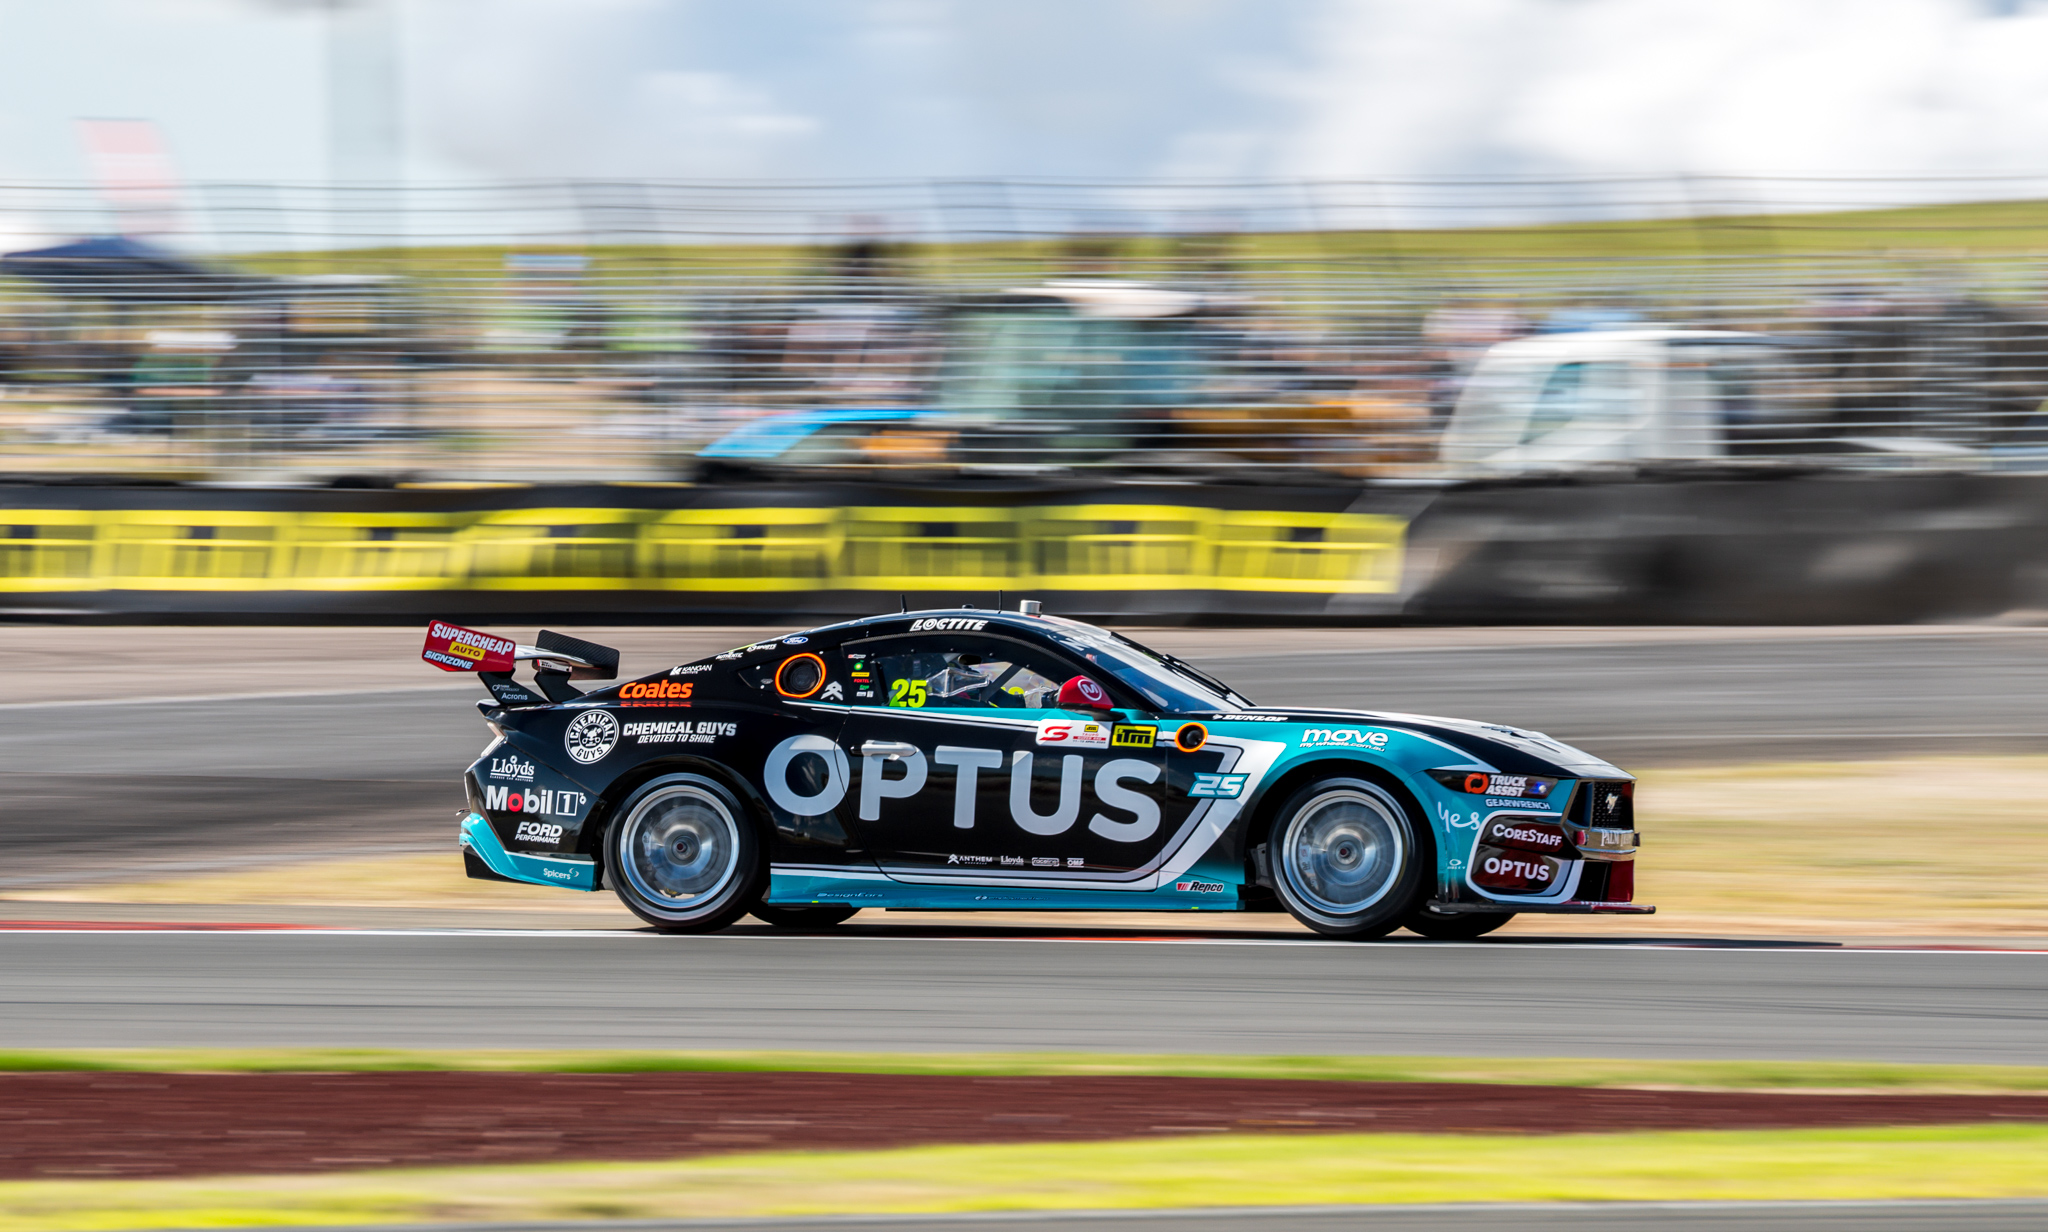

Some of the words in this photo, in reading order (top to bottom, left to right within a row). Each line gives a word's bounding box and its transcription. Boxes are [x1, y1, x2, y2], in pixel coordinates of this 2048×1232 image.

[909, 618, 988, 632] LOCTITE
[431, 623, 514, 655] SUPERCHEAP
[453, 645, 481, 657] AUTO
[424, 650, 474, 670] SIGNZONE
[889, 678, 928, 708] 25
[1082, 684, 1098, 694] M
[502, 692, 529, 701] Acronis
[570, 714, 614, 739] CHEMICAL
[623, 721, 693, 736] CHEMICAL
[696, 722, 737, 736] GUYS
[637, 734, 677, 744] DEVOTED
[676, 733, 688, 743] TO
[688, 734, 717, 744] SHINE
[1302, 729, 1389, 746] move
[576, 747, 604, 759] GUYS
[1315, 741, 1386, 752] wheels.com.au
[491, 758, 535, 777] Lloyds
[1197, 774, 1245, 796] 25
[1488, 774, 1528, 787] TRUCK
[763, 735, 1161, 842] OPTUS
[1485, 784, 1525, 797] ASSIST
[485, 784, 554, 815] Mobil
[1485, 799, 1551, 810] GEARWRENCH
[517, 821, 563, 838] FORD
[515, 833, 560, 845] PERFORMANCE
[959, 855, 993, 863] ANTHEM
[1000, 855, 1024, 864] Lloyds
[543, 867, 571, 880] Spicers
[1484, 857, 1550, 881] OPTUS
[1190, 880, 1224, 894] Repco
